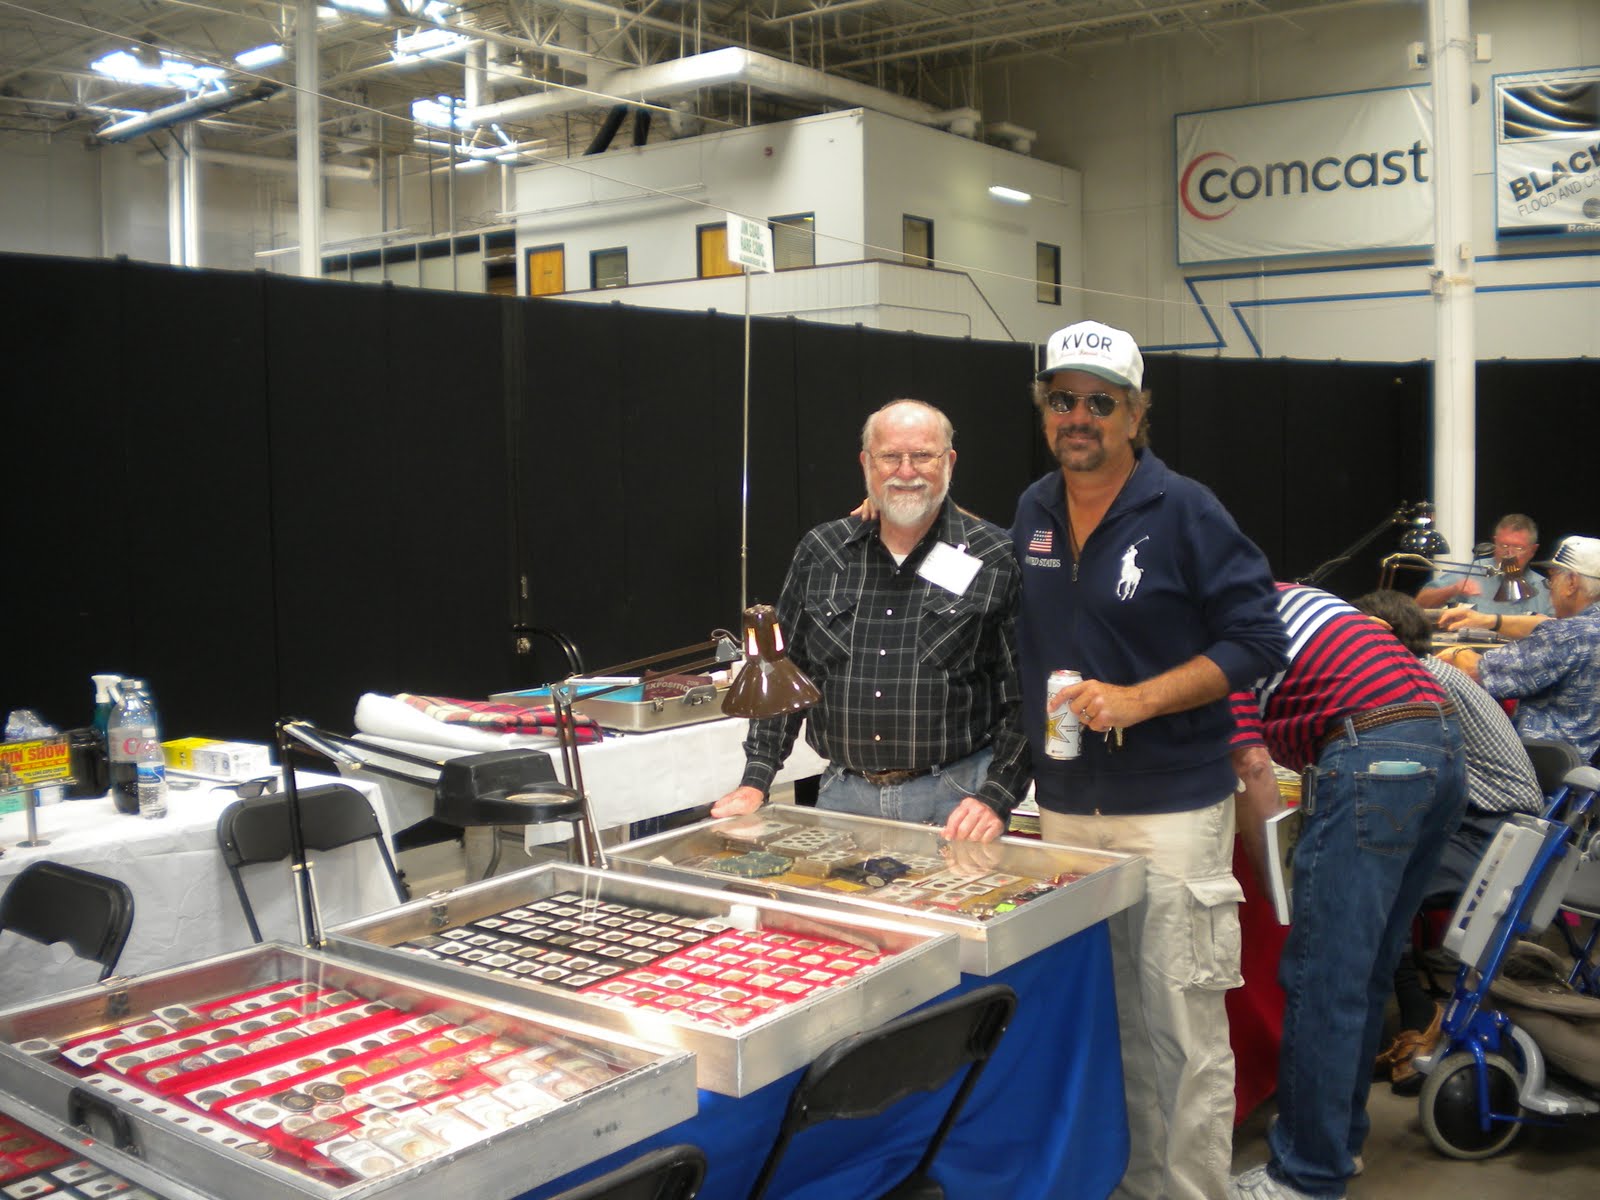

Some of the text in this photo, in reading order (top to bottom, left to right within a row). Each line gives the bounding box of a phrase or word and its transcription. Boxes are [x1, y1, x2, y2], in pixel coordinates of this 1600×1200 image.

[1199, 140, 1429, 204] comcast
[1517, 192, 1557, 217] FLOOD
[1559, 180, 1582, 200] AND
[1061, 332, 1112, 352] KVOR
[645, 681, 690, 692] EXPOSITIO
[0, 747, 23, 764] OIN
[28, 743, 66, 761] SHOW
